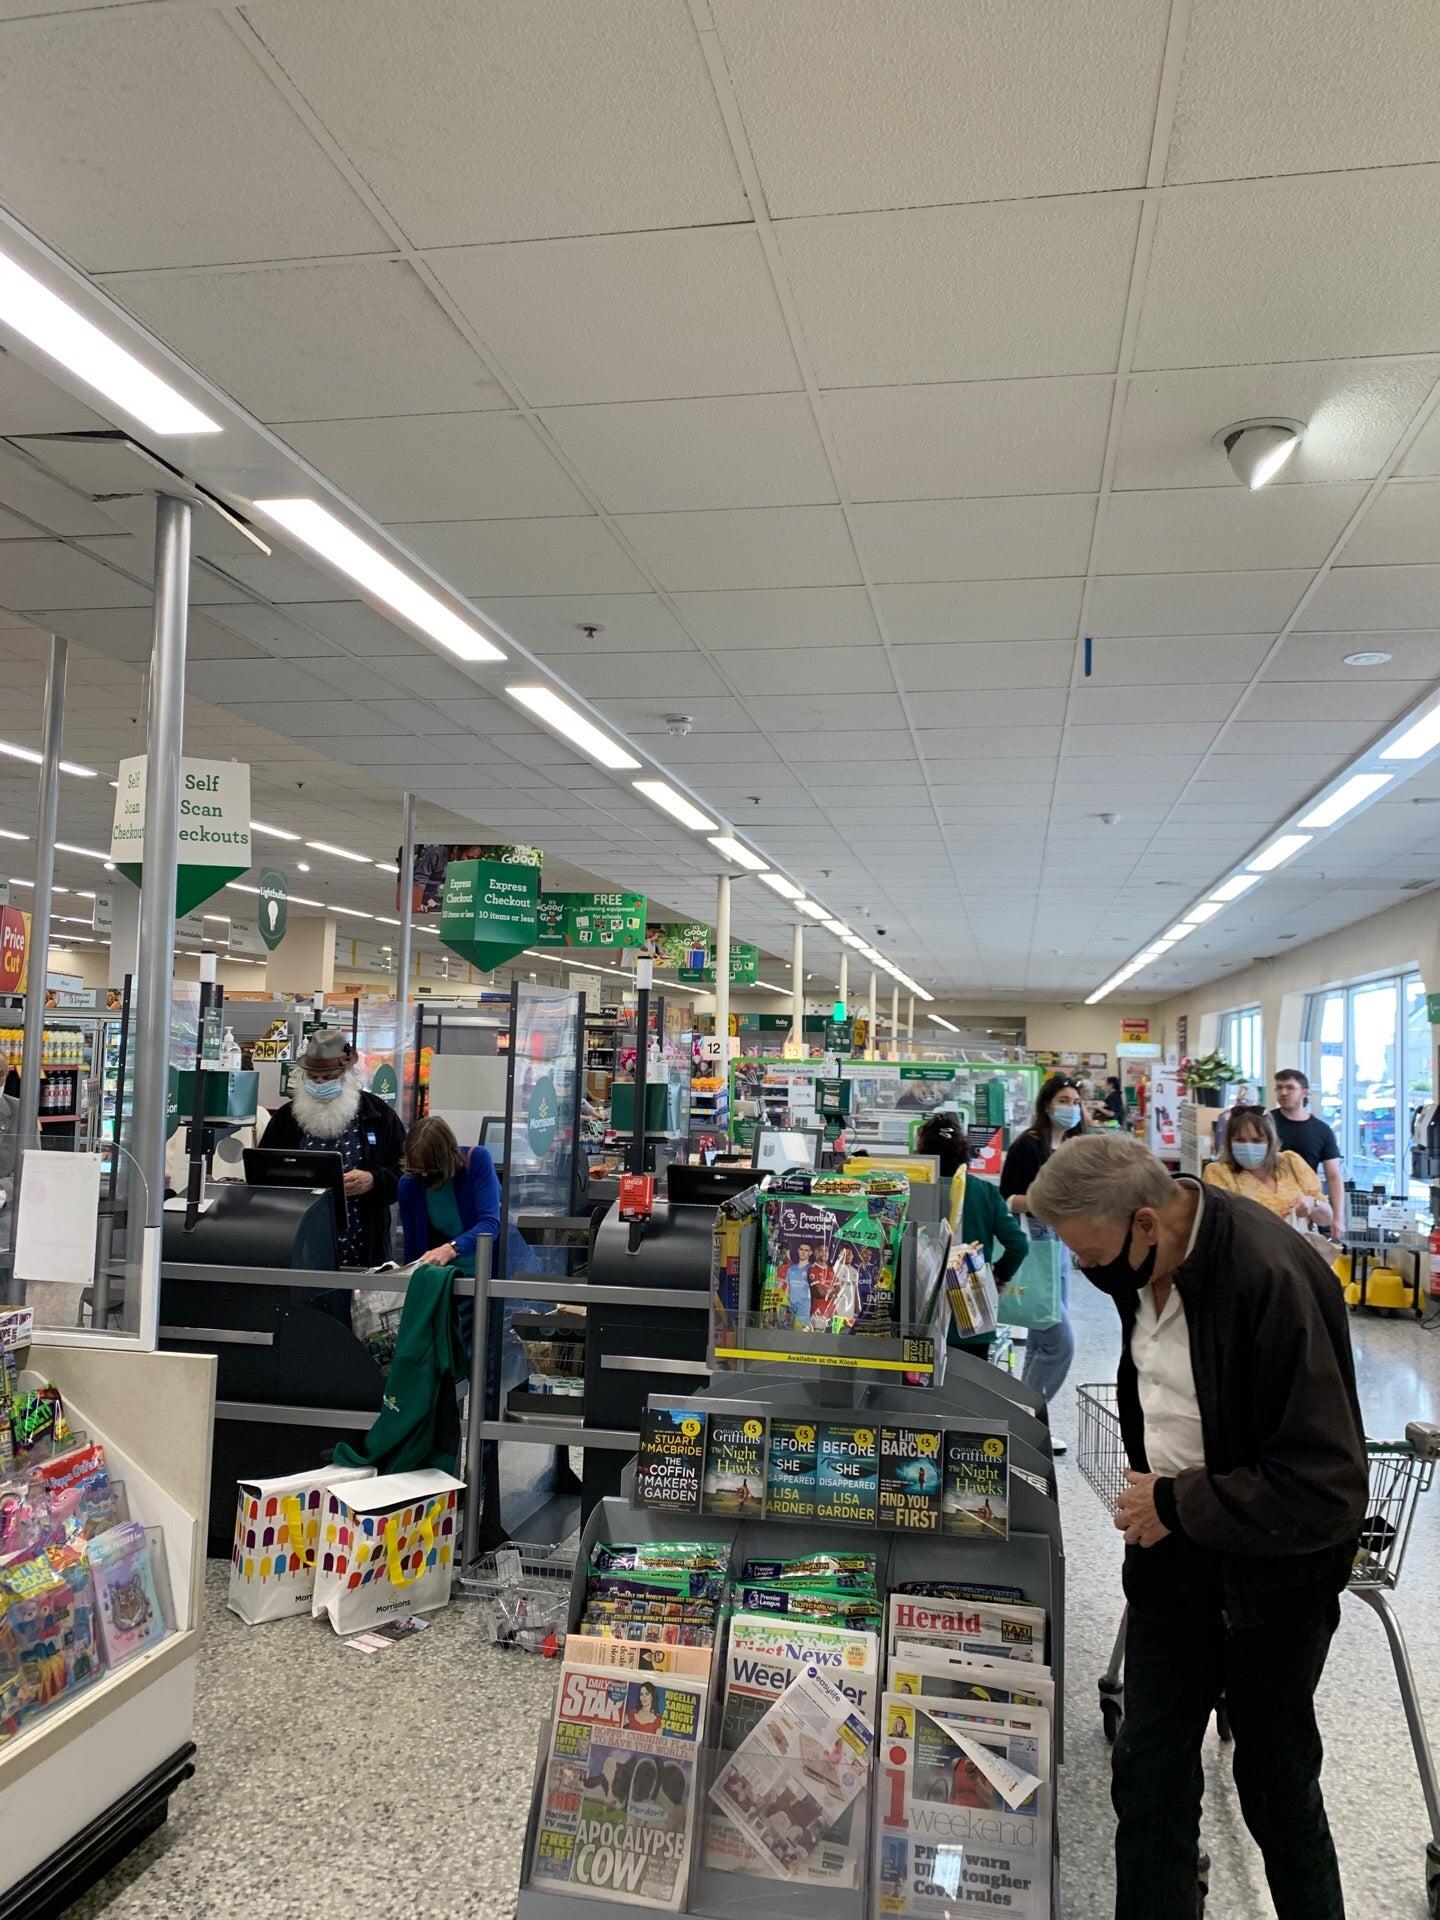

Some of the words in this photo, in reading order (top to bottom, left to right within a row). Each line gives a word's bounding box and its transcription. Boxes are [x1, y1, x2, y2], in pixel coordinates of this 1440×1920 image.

[185, 774, 220, 792] Self
[124, 800, 140, 814] Scan
[180, 800, 223, 818] Scan
[178, 825, 249, 844] eckouts
[450, 879, 472, 890] Express
[489, 879, 527, 892] Express
[260, 886, 287, 900] Lightbulbs
[446, 893, 473, 903] Checkout
[593, 894, 622, 905] FREE
[484, 894, 531, 907] Checkout
[540, 904, 564, 912] Good
[479, 911, 488, 919] 10
[490, 911, 510, 921] items
[521, 914, 535, 923] less
[540, 913, 563, 922] Grw
[3, 927, 25, 951] Price
[684, 929, 708, 937] Good
[684, 938, 707, 946] Grw
[4, 951, 21, 973] Cut
[707, 1043, 720, 1054] 12
[529, 1117, 556, 1129] Morrisons
[800, 1222, 832, 1233] League
[910, 1340, 919, 1362] 2018
[787, 1354, 816, 1363] Available
[839, 1358, 858, 1366] Kiosk
[686, 1424, 695, 1432] £5
[748, 1424, 757, 1433] £5
[800, 1430, 809, 1438] £5
[655, 1434, 696, 1445] STUART
[713, 1429, 761, 1445] Griffiths
[858, 1433, 868, 1443] £5
[899, 1429, 941, 1443] Linwd
[823, 1441, 876, 1457] BEFORE
[921, 1439, 931, 1448] £5
[988, 1443, 998, 1452] £5
[647, 1445, 702, 1456] MACBRIDE
[722, 1445, 757, 1463] Night
[950, 1447, 1002, 1464] Griffiths
[665, 1457, 682, 1465] THE
[717, 1459, 760, 1476] Hawks
[776, 1459, 800, 1472] SHE
[650, 1465, 695, 1478] COFFIN
[835, 1463, 860, 1476] SHE
[961, 1463, 998, 1482] Night
[644, 1476, 698, 1490] MAKER'S
[768, 1474, 816, 1486] SAPPEARED
[819, 1478, 876, 1490] DISAPPEARED
[955, 1478, 1003, 1496] Hawks
[644, 1488, 697, 1502] GARDEN
[773, 1488, 800, 1500] LISA
[833, 1492, 860, 1505] LISA
[880, 1492, 905, 1507] FIND
[907, 1495, 929, 1509] YOU
[767, 1502, 814, 1515] ARDNER
[817, 1505, 875, 1521] GARDNER
[896, 1509, 938, 1529] FIRST
[760, 1593, 781, 1601] Premier
[376, 1600, 411, 1614] Morrisons
[895, 1603, 982, 1633] Herald
[1004, 1624, 1030, 1636] TAXI
[610, 1645, 618, 1664] blow
[786, 1643, 842, 1667] News
[588, 1678, 609, 1688] DAILY
[815, 1674, 841, 1703] easylife
[562, 1674, 624, 1722] STAR
[664, 1689, 697, 1705] NIGELLA
[664, 1701, 695, 1714] SARNIE
[670, 1712, 694, 1725] RIGHT
[558, 1723, 590, 1738] FREE
[660, 1718, 693, 1735] SCREAM
[595, 1736, 608, 1745] TO
[609, 1738, 633, 1749] SAVE
[635, 1742, 654, 1751] THE
[670, 1738, 697, 1750] PLAN
[884, 1745, 909, 1828] i
[545, 1811, 570, 1821] Racing
[571, 1814, 577, 1822] &
[630, 1805, 666, 1818] Pardon?
[544, 1819, 555, 1828] TV
[556, 1822, 576, 1832] mags
[910, 1807, 1035, 1848] weekend
[542, 1832, 575, 1849] FREE
[575, 1819, 685, 1860] APOCALYPSE
[576, 1844, 648, 1892] COW
[965, 1854, 1010, 1871] warn
[962, 1868, 1031, 1891] tougher
[913, 1881, 963, 1900] Covd
[967, 1889, 1012, 1906] rules
